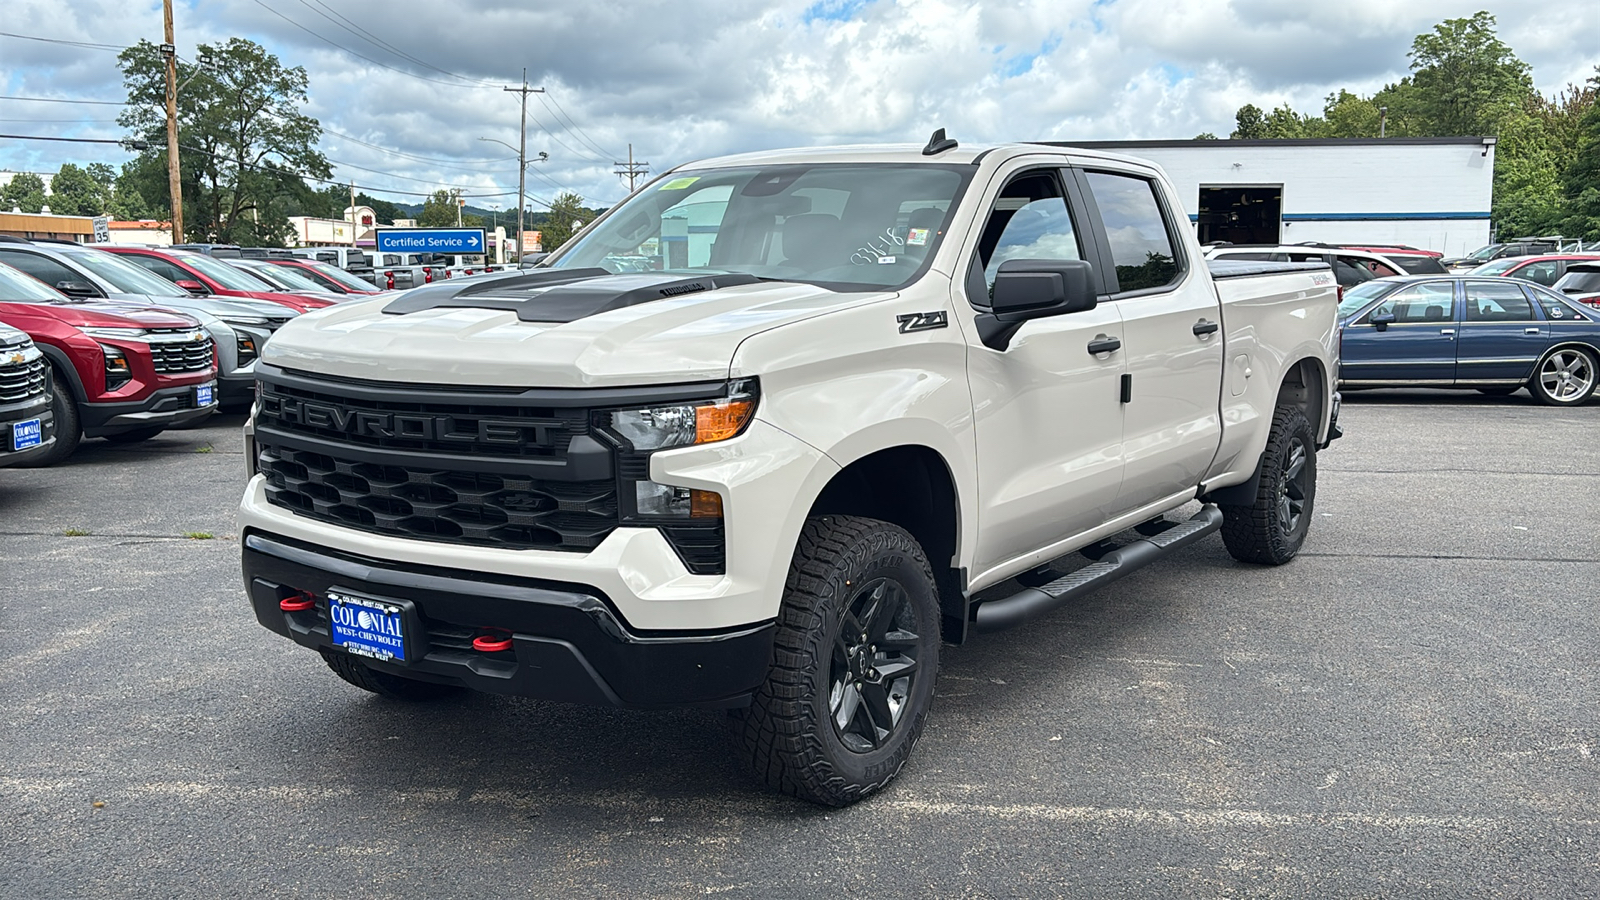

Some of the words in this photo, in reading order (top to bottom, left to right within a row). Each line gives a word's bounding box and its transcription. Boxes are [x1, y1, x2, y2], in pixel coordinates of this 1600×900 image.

[96, 231, 109, 243] 35
[384, 237, 426, 247] Certified
[428, 237, 463, 247] Service
[896, 310, 948, 334] Z71
[261, 393, 571, 446] CHEVROLET
[331, 604, 404, 638] COLONIAL
